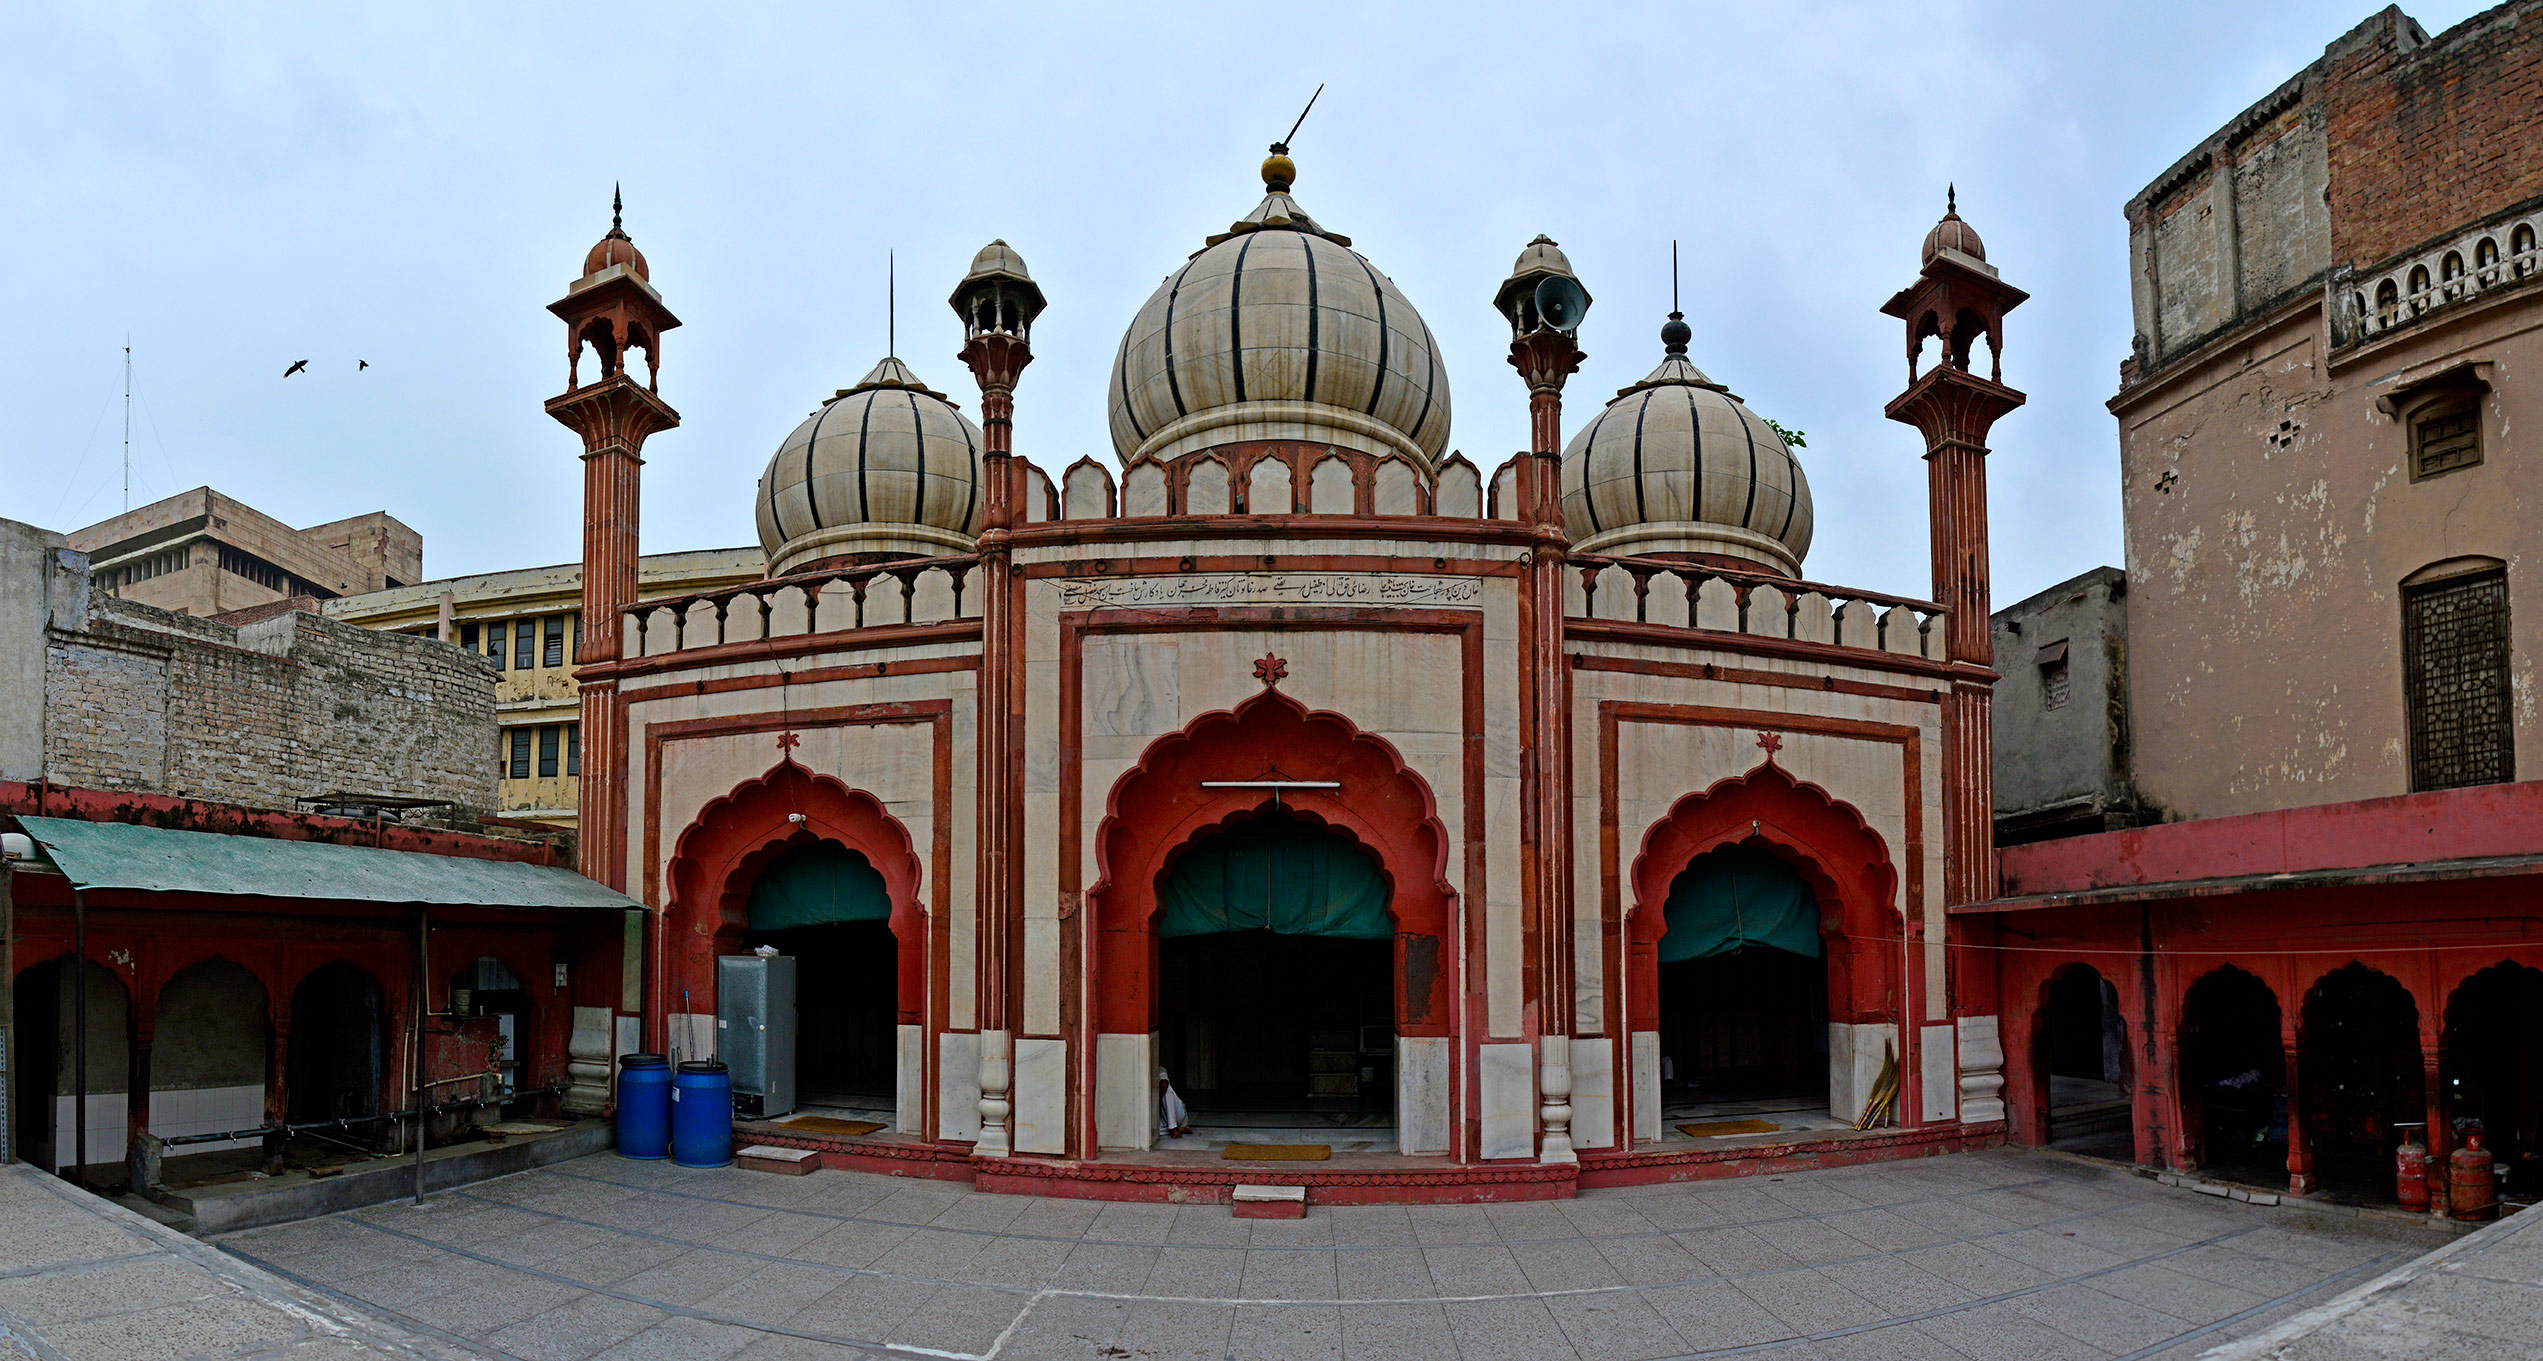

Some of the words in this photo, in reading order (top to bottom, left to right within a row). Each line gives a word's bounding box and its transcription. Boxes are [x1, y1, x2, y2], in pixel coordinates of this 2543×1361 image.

[1302, 578, 1323, 598] طفیل
[1410, 580, 1444, 600] شجاعت
[1452, 584, 1467, 601] دین
[1462, 584, 1479, 600] خان
